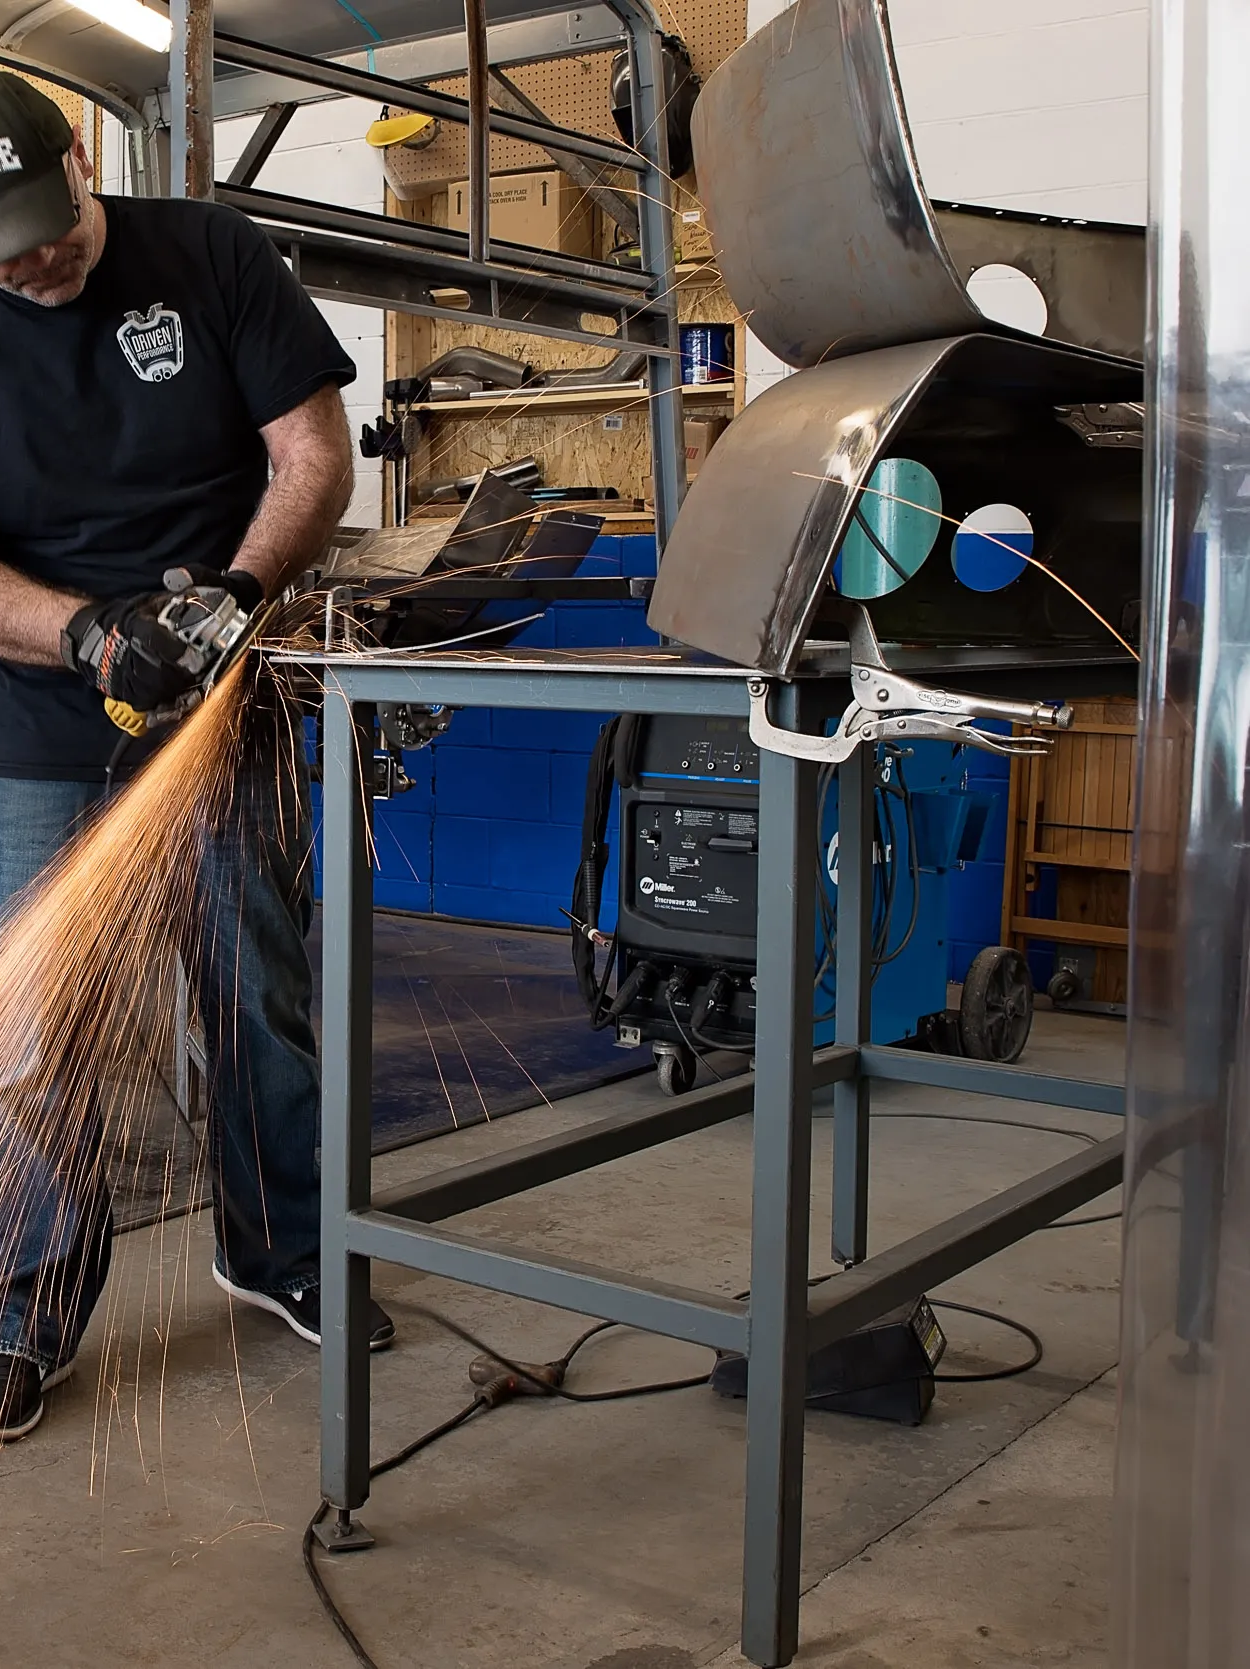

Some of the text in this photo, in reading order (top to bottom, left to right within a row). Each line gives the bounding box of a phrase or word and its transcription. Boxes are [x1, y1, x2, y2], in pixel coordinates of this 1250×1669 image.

[513, 188, 527, 196] PLACE
[131, 325, 173, 353] DRIVEN
[136, 343, 175, 361] PERFORMANCE
[654, 895, 697, 907] Syncrowave 200
